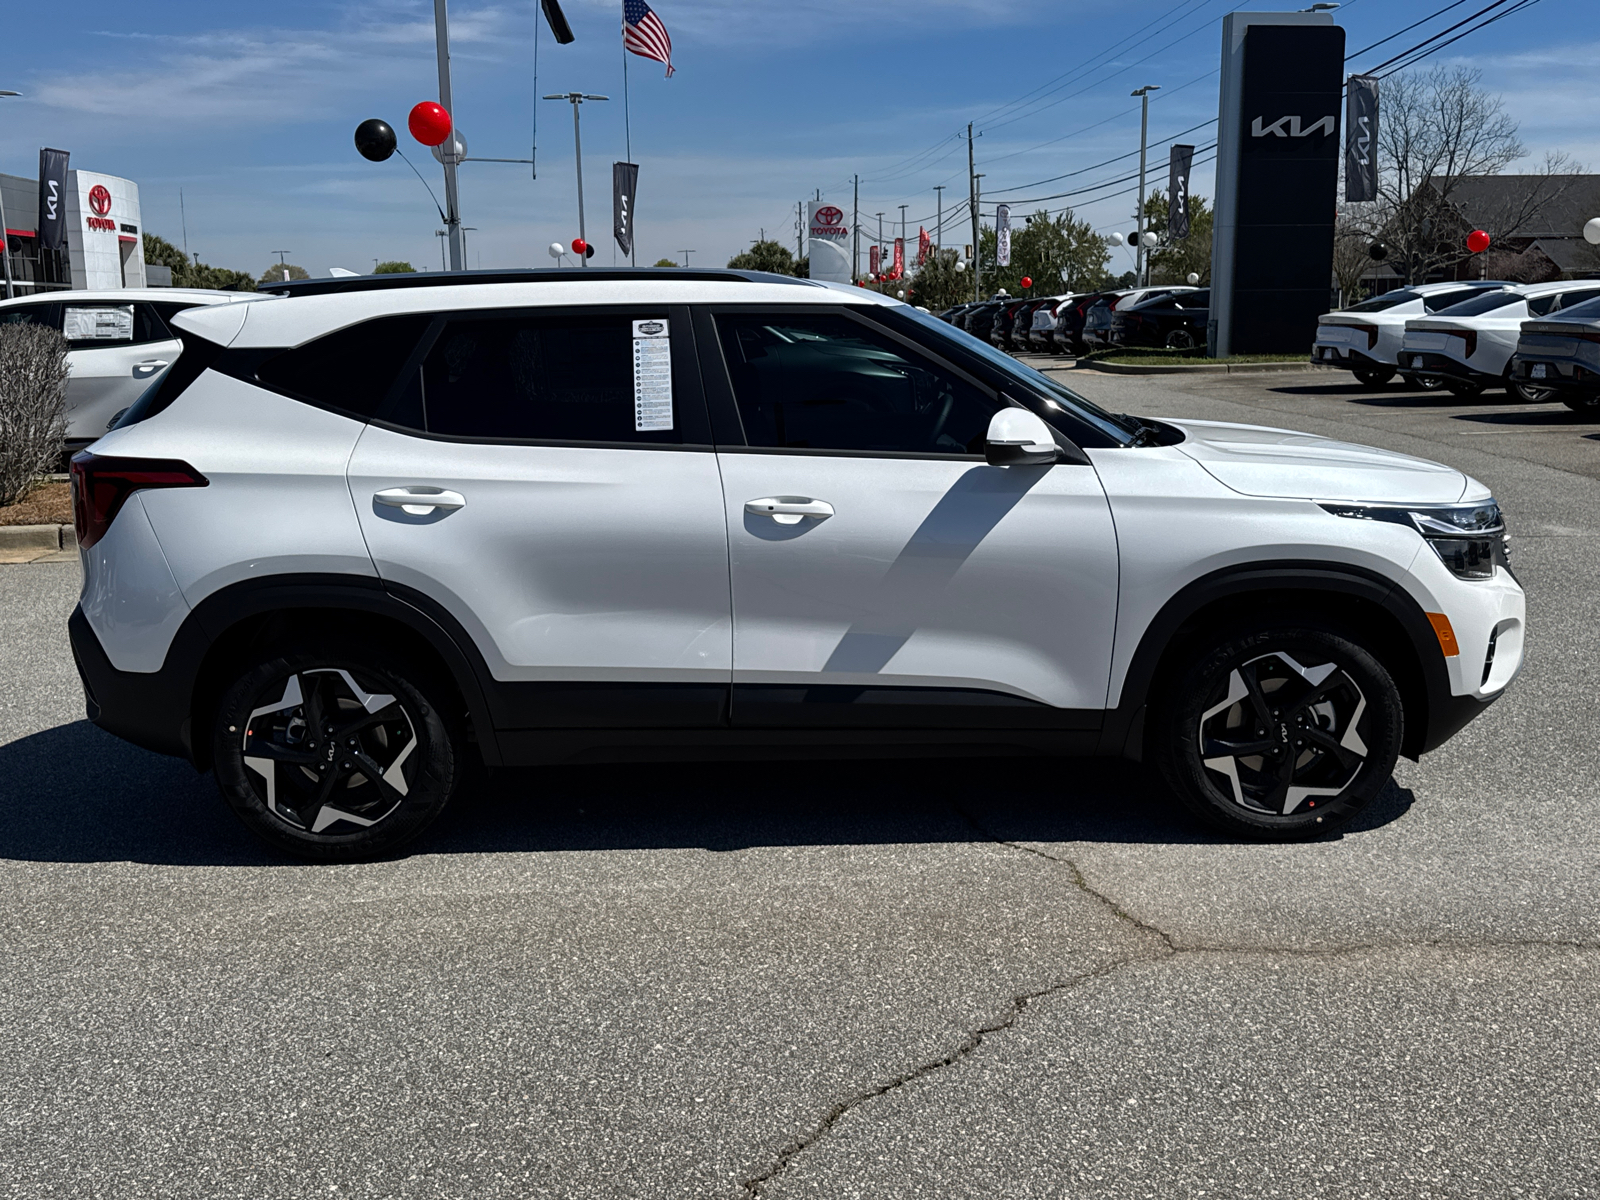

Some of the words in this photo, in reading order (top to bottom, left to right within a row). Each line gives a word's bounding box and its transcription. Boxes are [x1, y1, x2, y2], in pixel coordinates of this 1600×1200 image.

[1251, 115, 1335, 137] KIA
[47, 180, 58, 220] KIA
[86, 217, 116, 231] TOYOTA
[811, 227, 848, 235] TOYOTA
